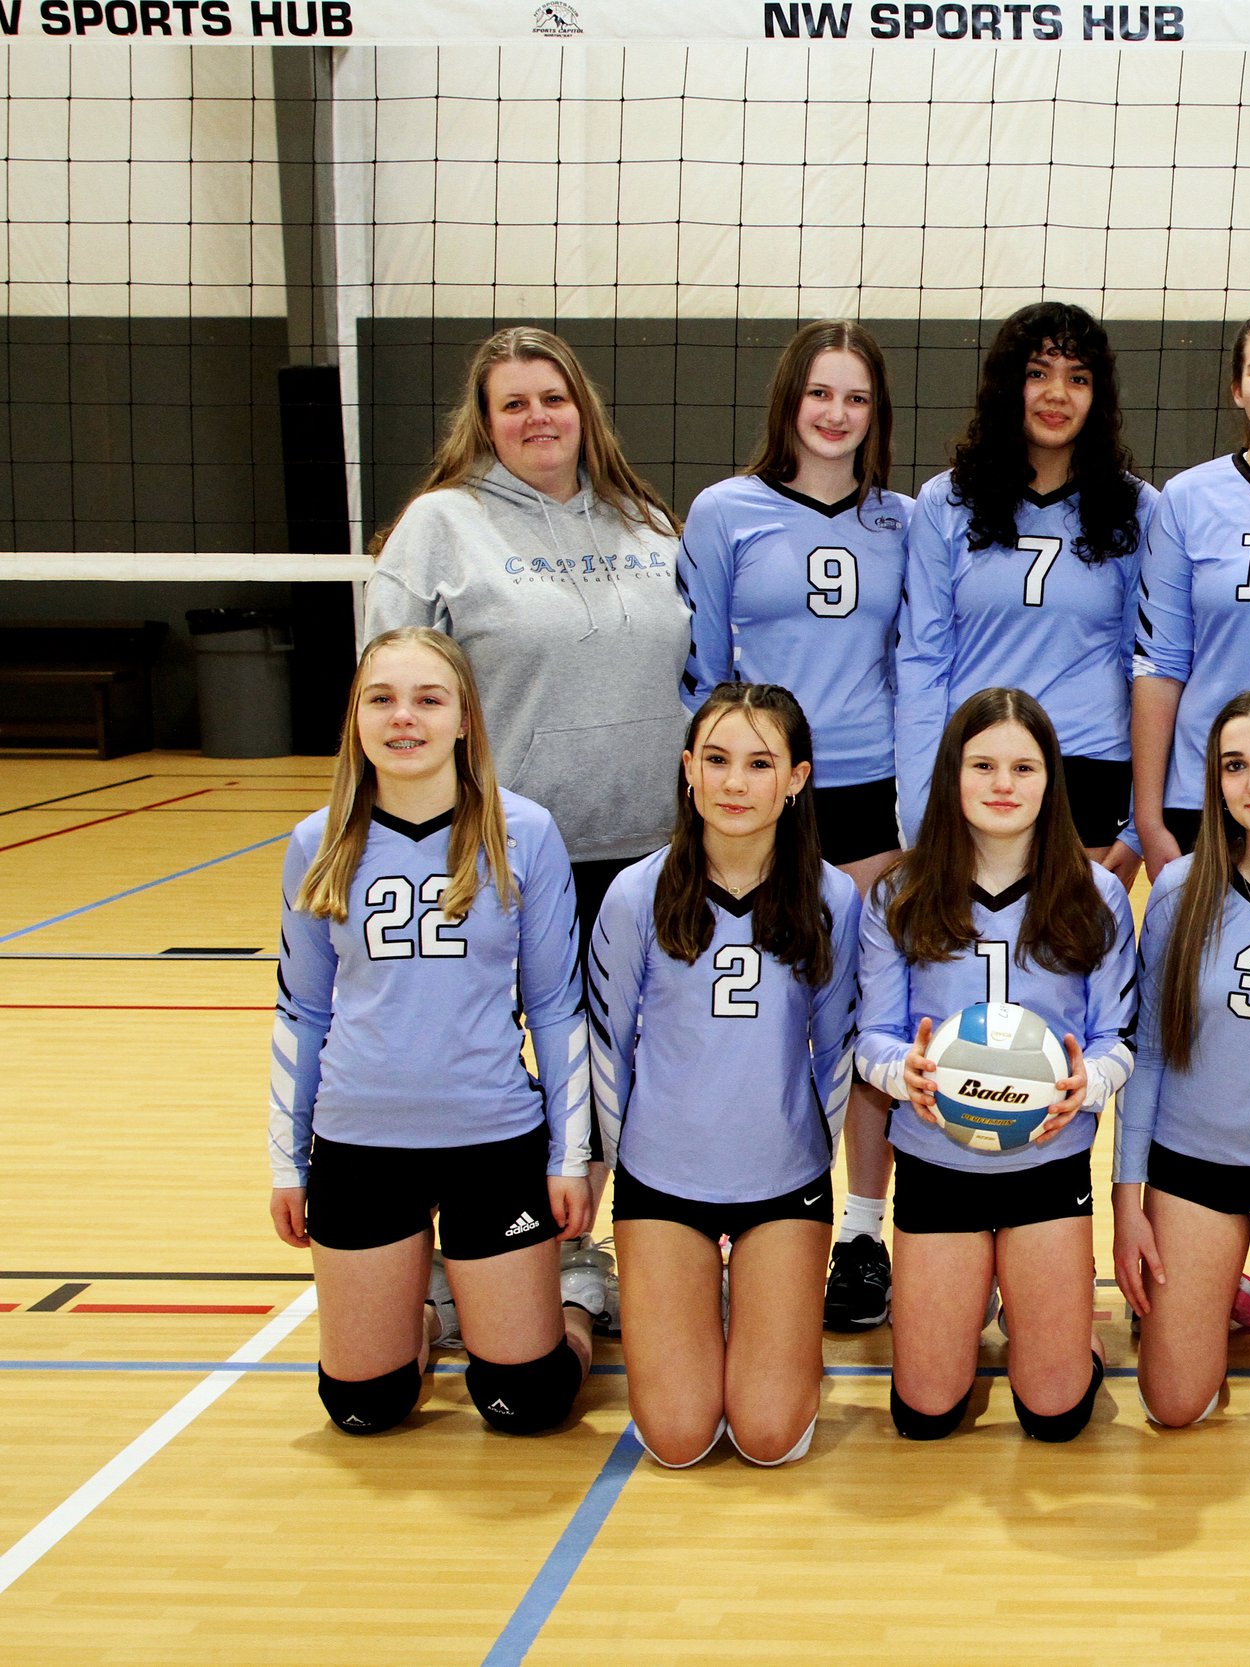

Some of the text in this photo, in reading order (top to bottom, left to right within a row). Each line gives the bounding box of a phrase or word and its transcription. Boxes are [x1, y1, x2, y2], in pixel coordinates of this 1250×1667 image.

[40, 0, 232, 36] SPORTS
[251, 1, 353, 37] HUB
[764, 3, 1185, 41] NW SPORTS HUB
[505, 552, 665, 575] CAPITAL
[513, 575, 621, 586] Volleball
[806, 546, 859, 619] 9
[1017, 535, 1062, 607] 7
[364, 873, 468, 961] 22
[712, 944, 761, 1019] 2
[975, 940, 1020, 1006] 1
[958, 1078, 1030, 1104] Baden
[505, 1220, 540, 1237] adidas
